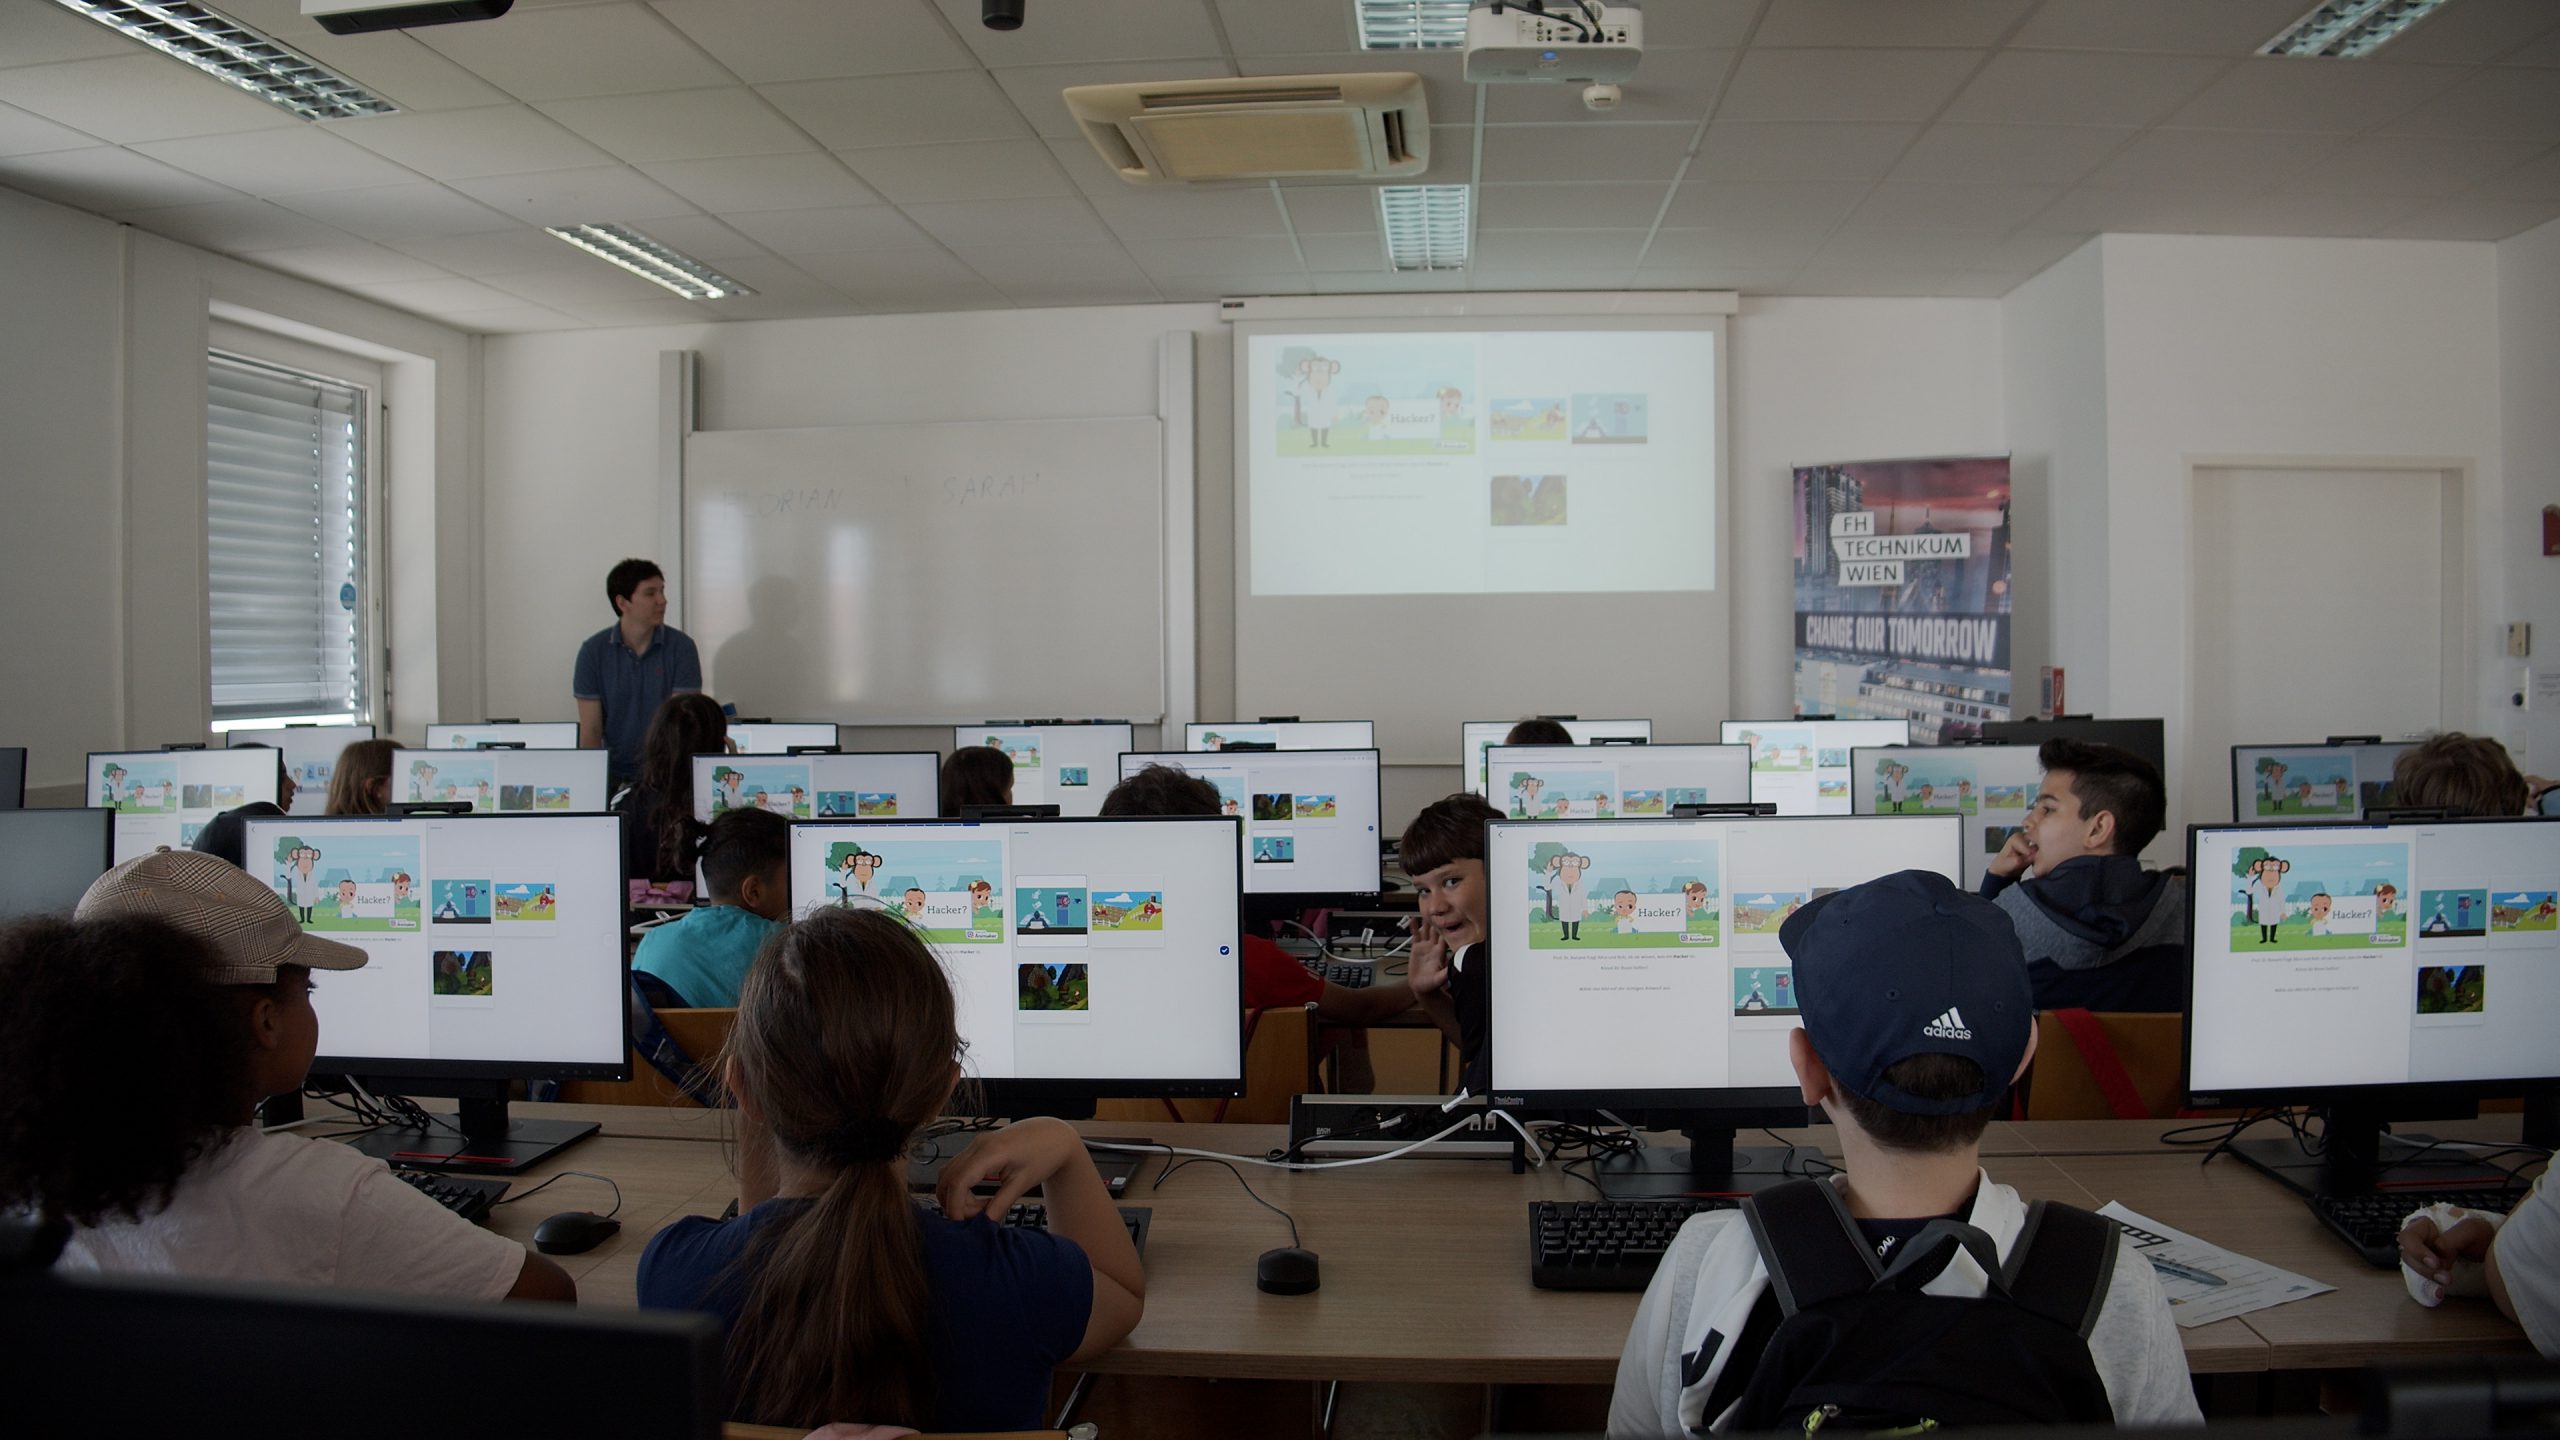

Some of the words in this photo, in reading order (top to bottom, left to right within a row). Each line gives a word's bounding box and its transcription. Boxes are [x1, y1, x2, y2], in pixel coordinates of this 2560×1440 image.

[1389, 412, 1435, 426] Hacker?
[1843, 515, 1868, 532] FH
[1844, 537, 1963, 557] TECHNIKUM
[1846, 564, 1898, 582] WIEN
[1806, 615, 1854, 650] CHANGE
[1855, 616, 1886, 651] OUR
[1888, 616, 1997, 663] TOMORROW
[357, 895, 391, 905] Hacker?
[927, 905, 968, 915] Hacker?
[1638, 907, 1682, 918] Hacker?
[2332, 909, 2372, 920] Hacker?
[1923, 1025, 1972, 1040] adidas
